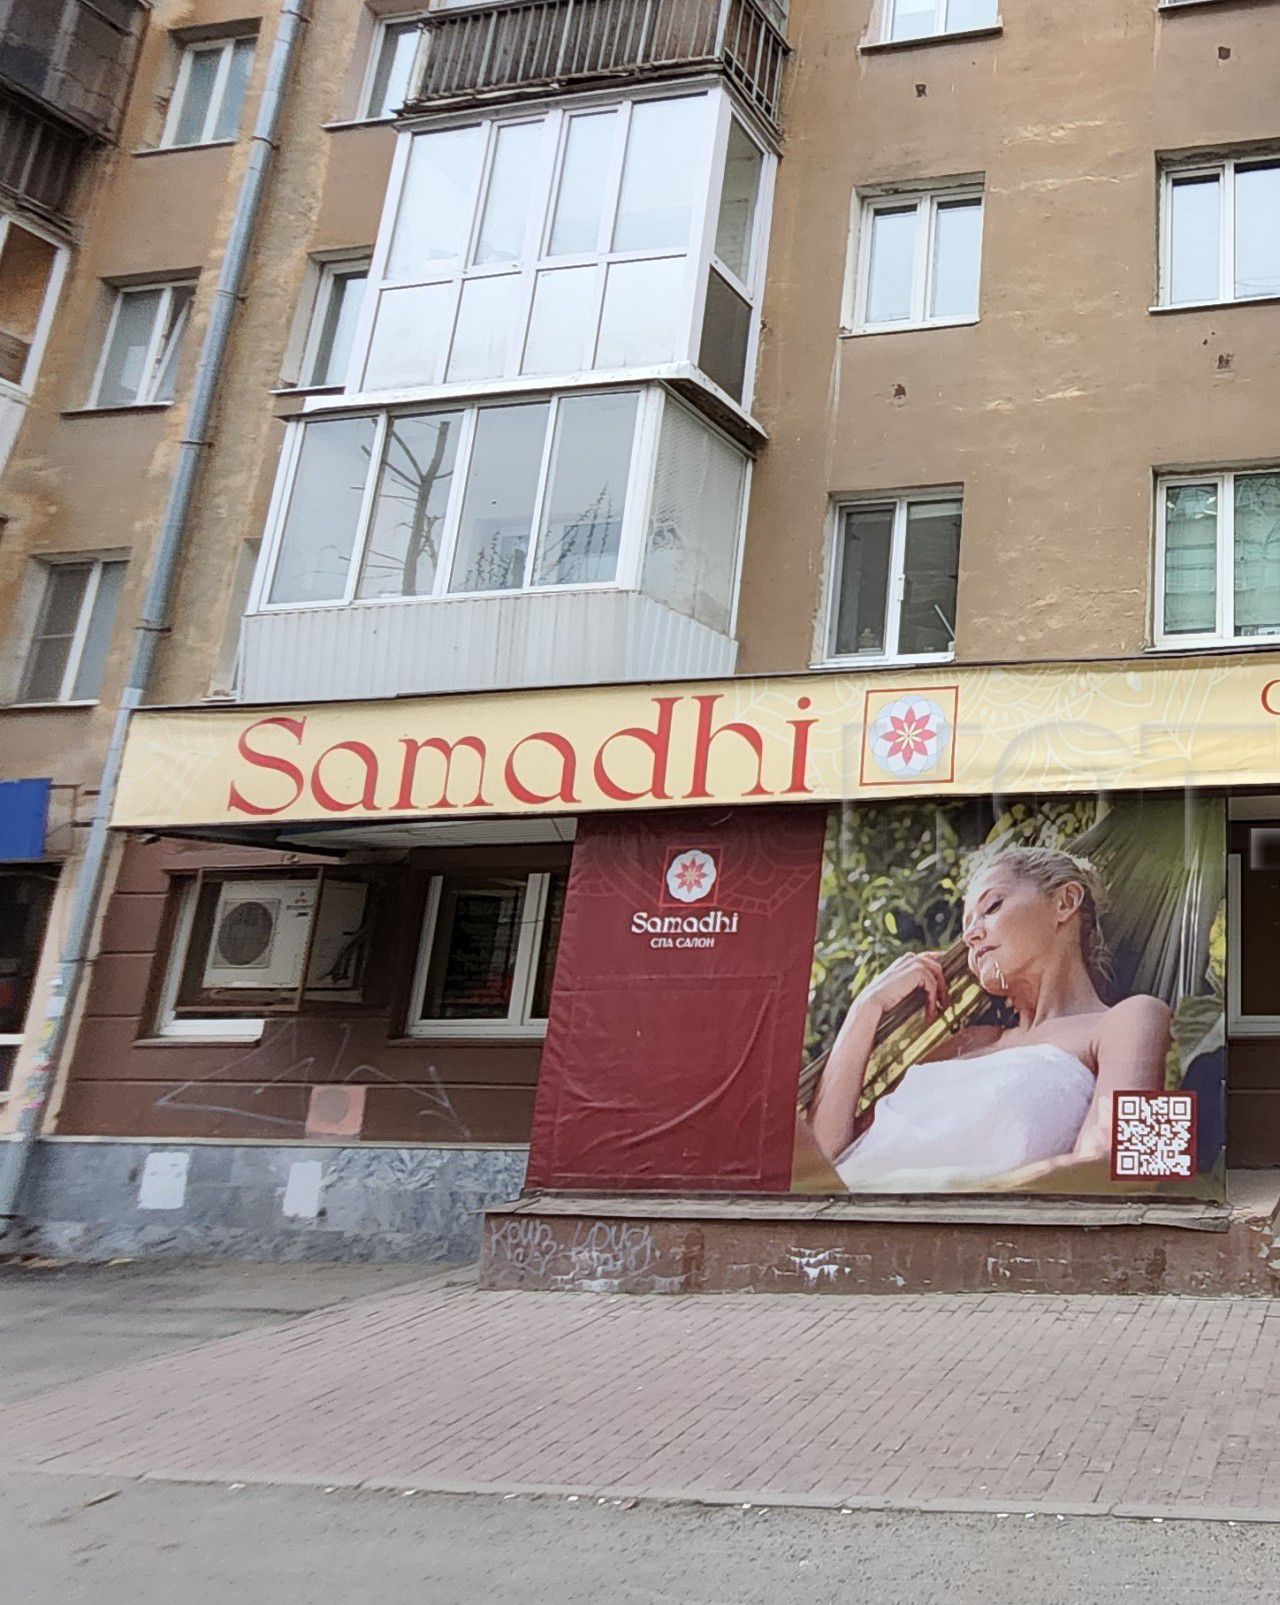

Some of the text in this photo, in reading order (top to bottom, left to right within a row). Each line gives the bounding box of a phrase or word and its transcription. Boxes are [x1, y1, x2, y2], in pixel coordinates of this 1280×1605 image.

[227, 693, 820, 816] Samadhi
[631, 911, 739, 934] Samadhi
[650, 937, 715, 949] СПА САЛОН
